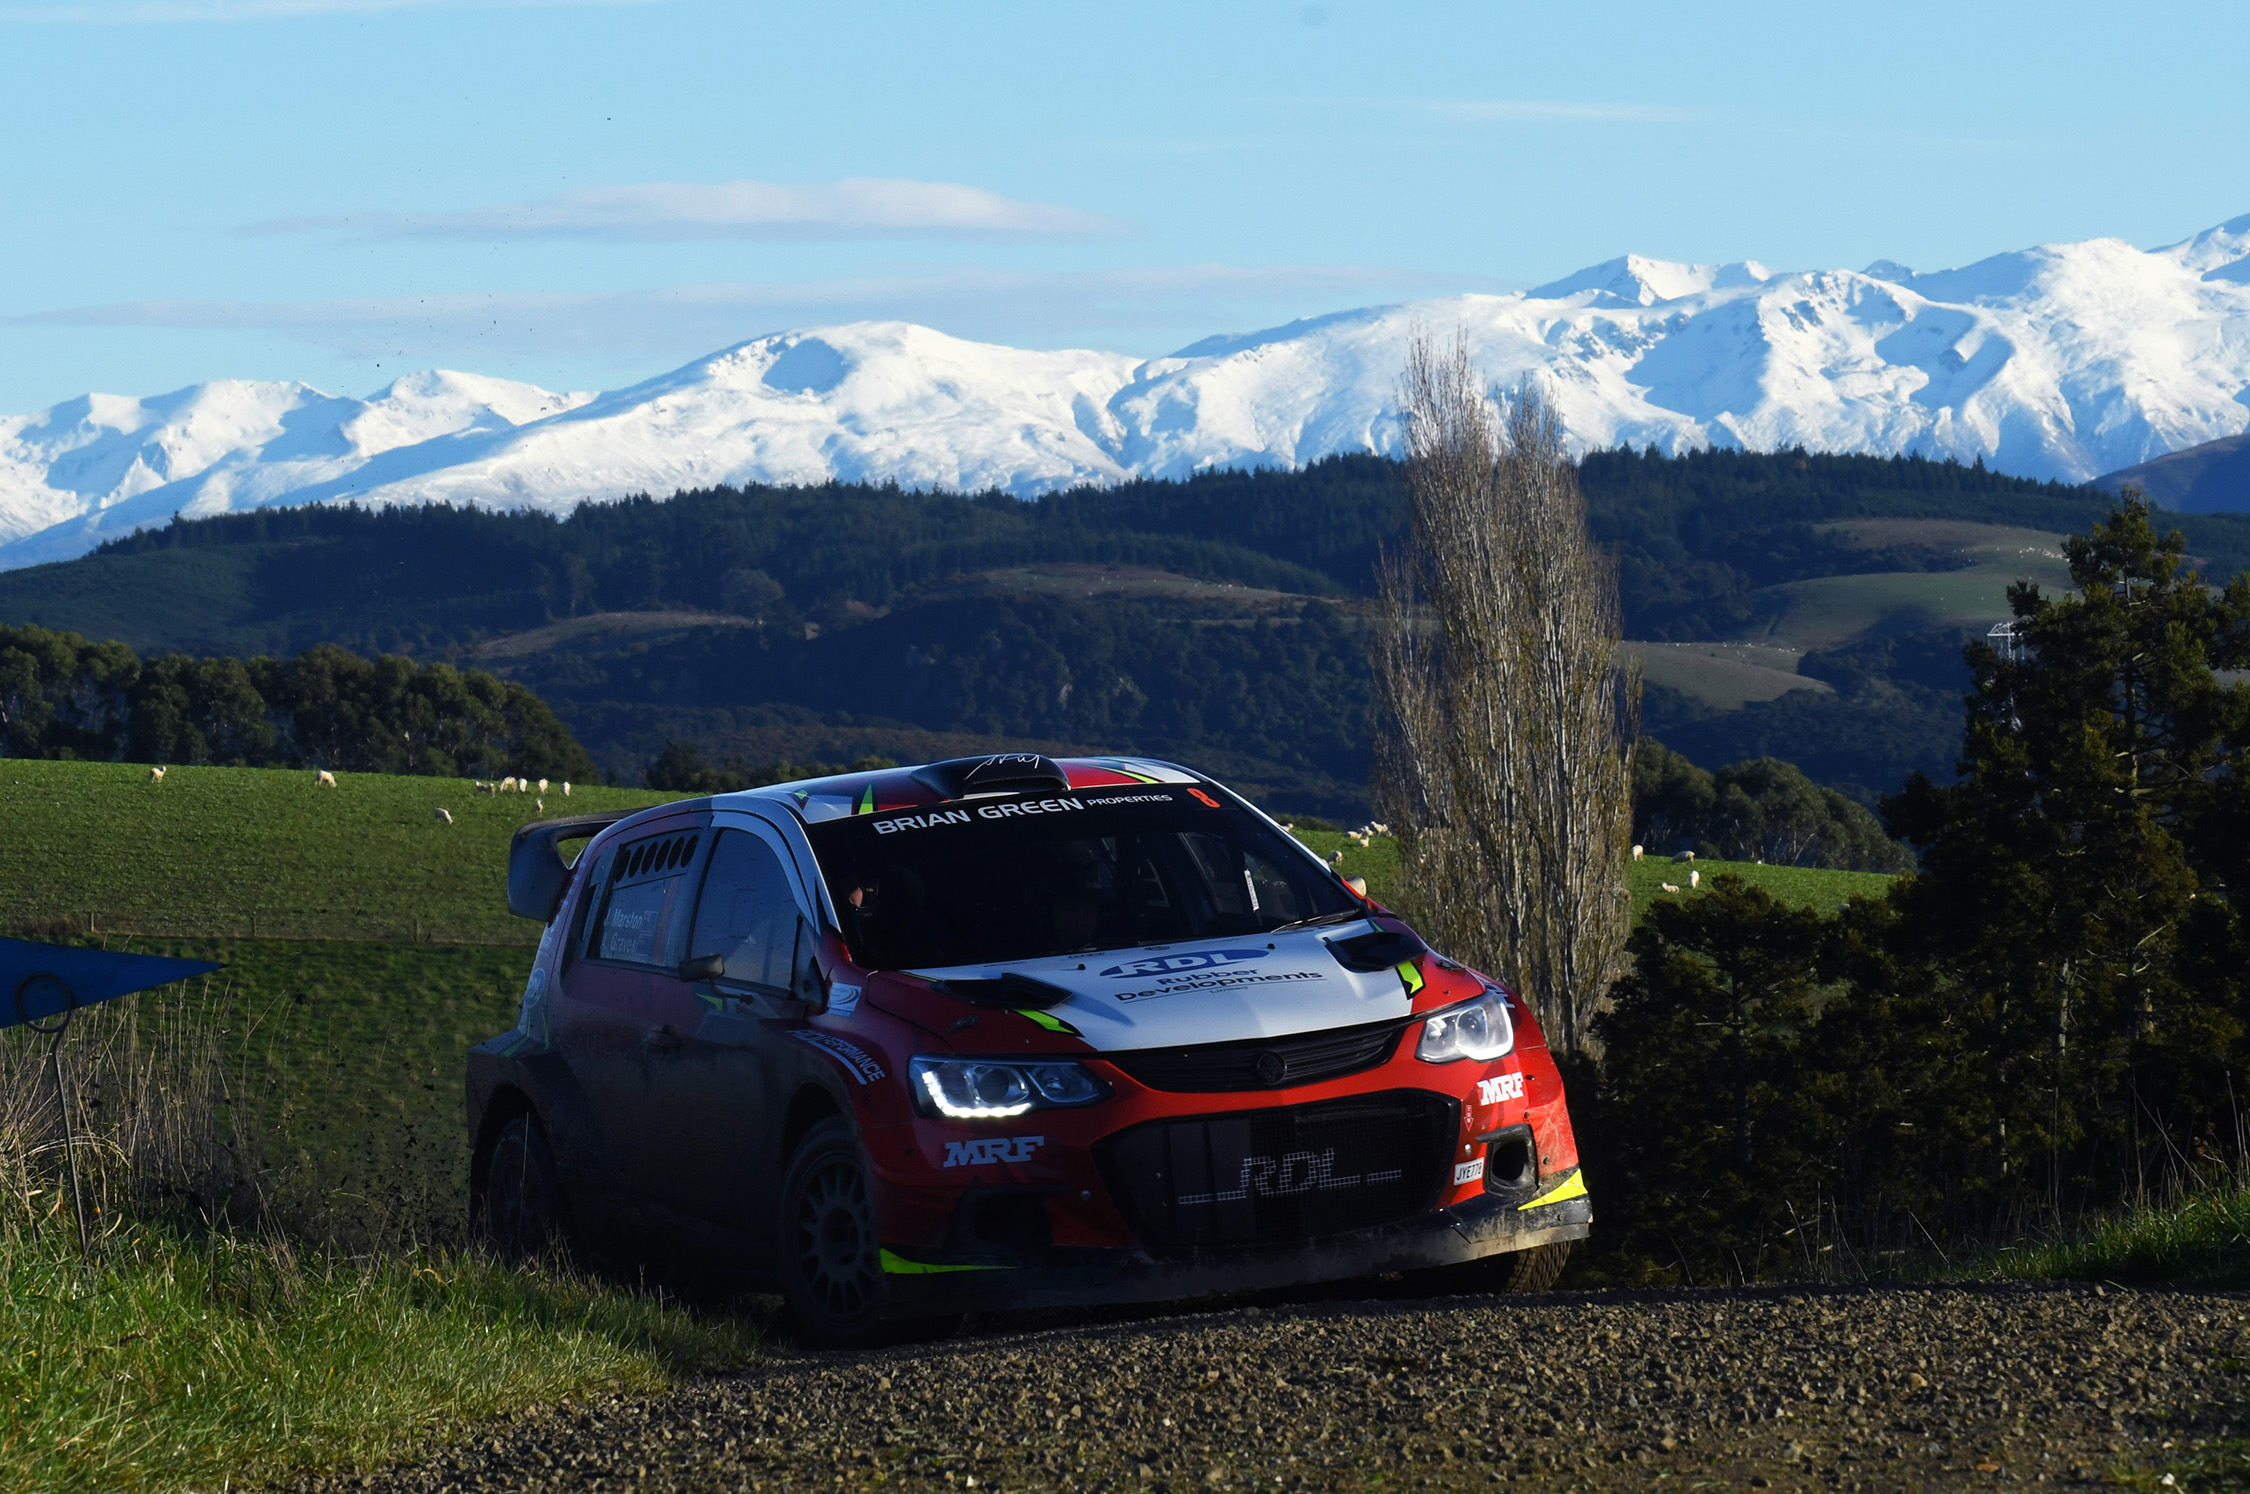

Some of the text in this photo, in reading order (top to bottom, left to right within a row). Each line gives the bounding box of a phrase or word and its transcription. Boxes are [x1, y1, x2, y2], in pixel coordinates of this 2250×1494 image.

[1186, 787, 1221, 809] 8
[872, 793, 1174, 835] BRIAN GREEN PROPERTIES
[1115, 951, 1250, 977] RDL
[1156, 967, 1259, 985] Rubber
[1114, 971, 1324, 1001] Developments
[1477, 1071, 1524, 1106] MRF
[943, 1135, 1045, 1168] MRF
[1237, 1147, 1362, 1199] RDL
